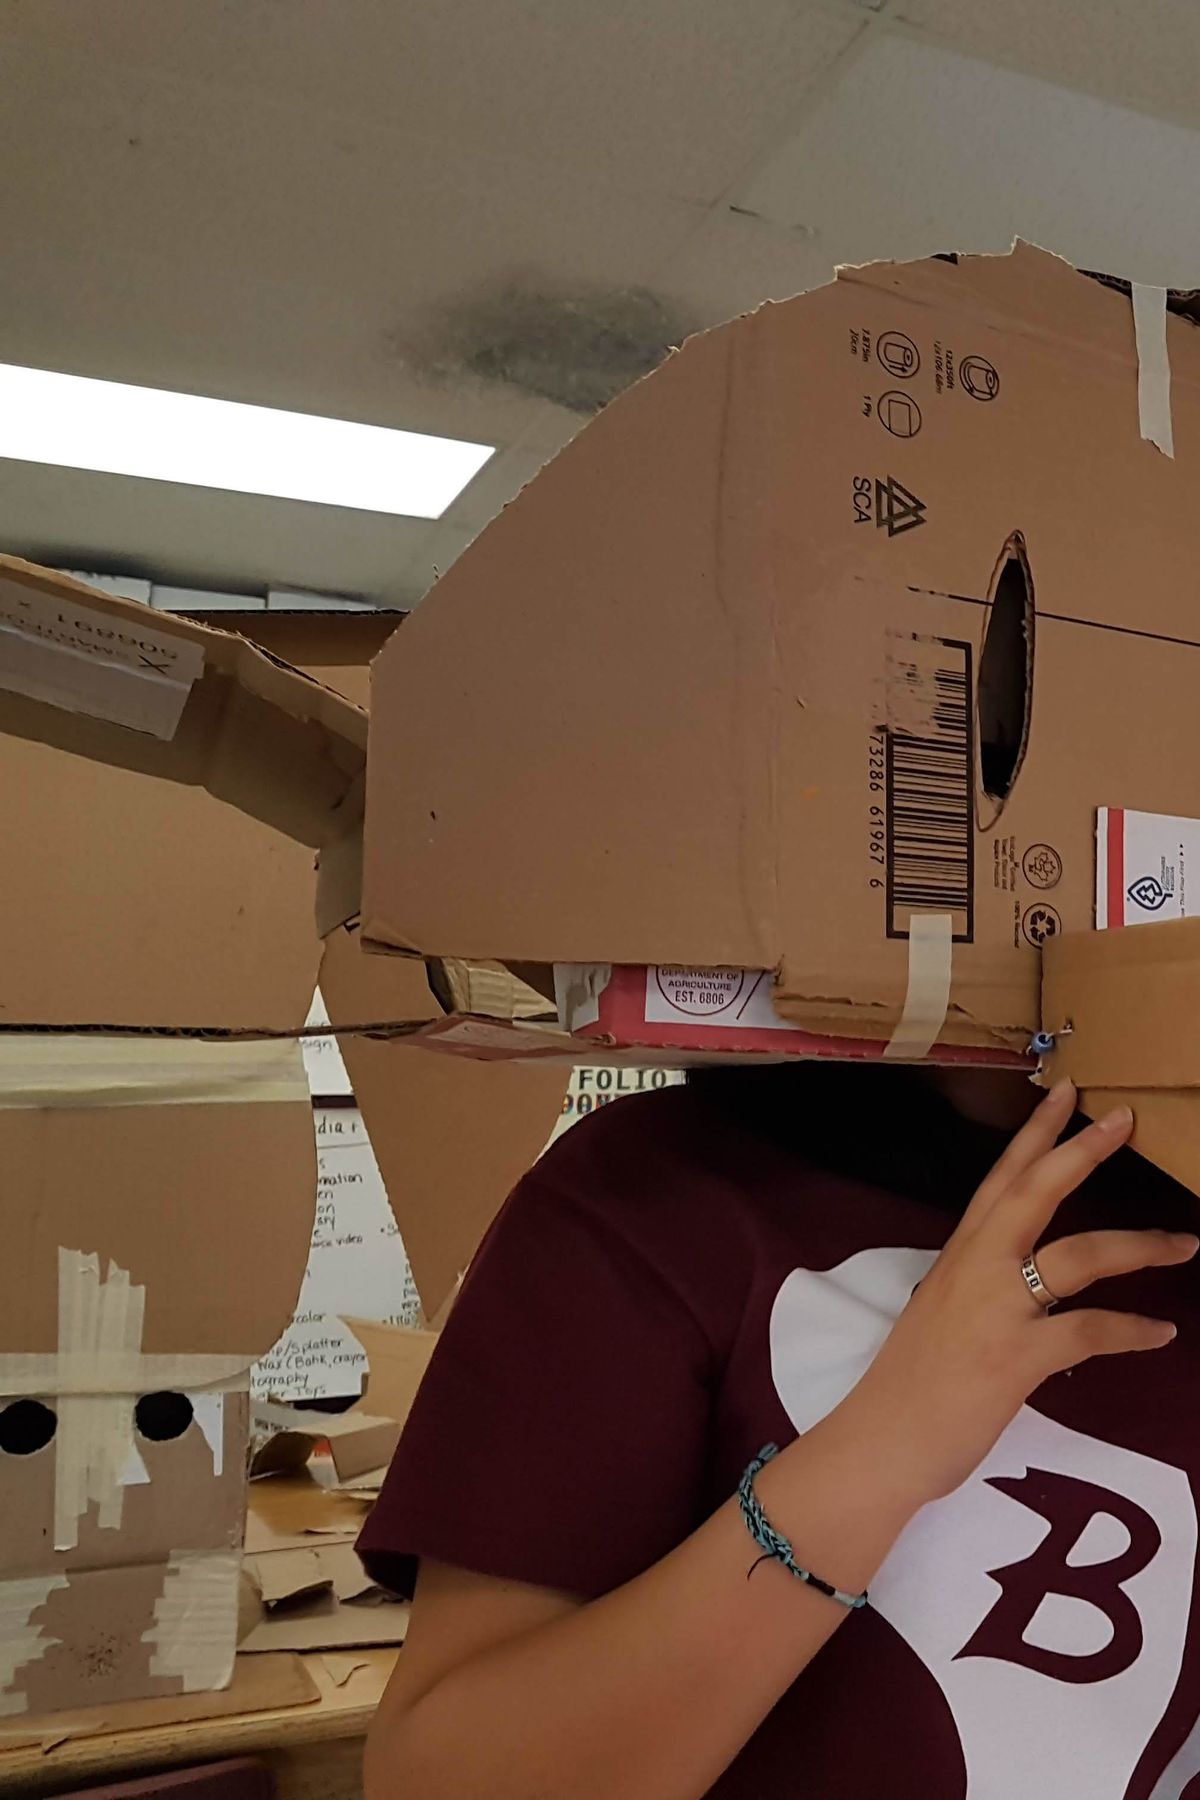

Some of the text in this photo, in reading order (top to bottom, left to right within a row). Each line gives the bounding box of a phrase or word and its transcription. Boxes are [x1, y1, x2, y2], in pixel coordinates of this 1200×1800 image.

[852, 475, 872, 524] SCA
[868, 734, 885, 889] 73286 61967 6
[726, 972, 739, 982] OF
[667, 979, 733, 992] AGRICULTURE
[674, 990, 697, 1004] EST.
[302, 1039, 333, 1055] sign
[578, 1068, 667, 1091] FOLIO
[294, 1310, 326, 1324] color
[258, 1359, 283, 1372] Wax
[251, 1373, 309, 1390] tography
[951, 1466, 1162, 1685] B
